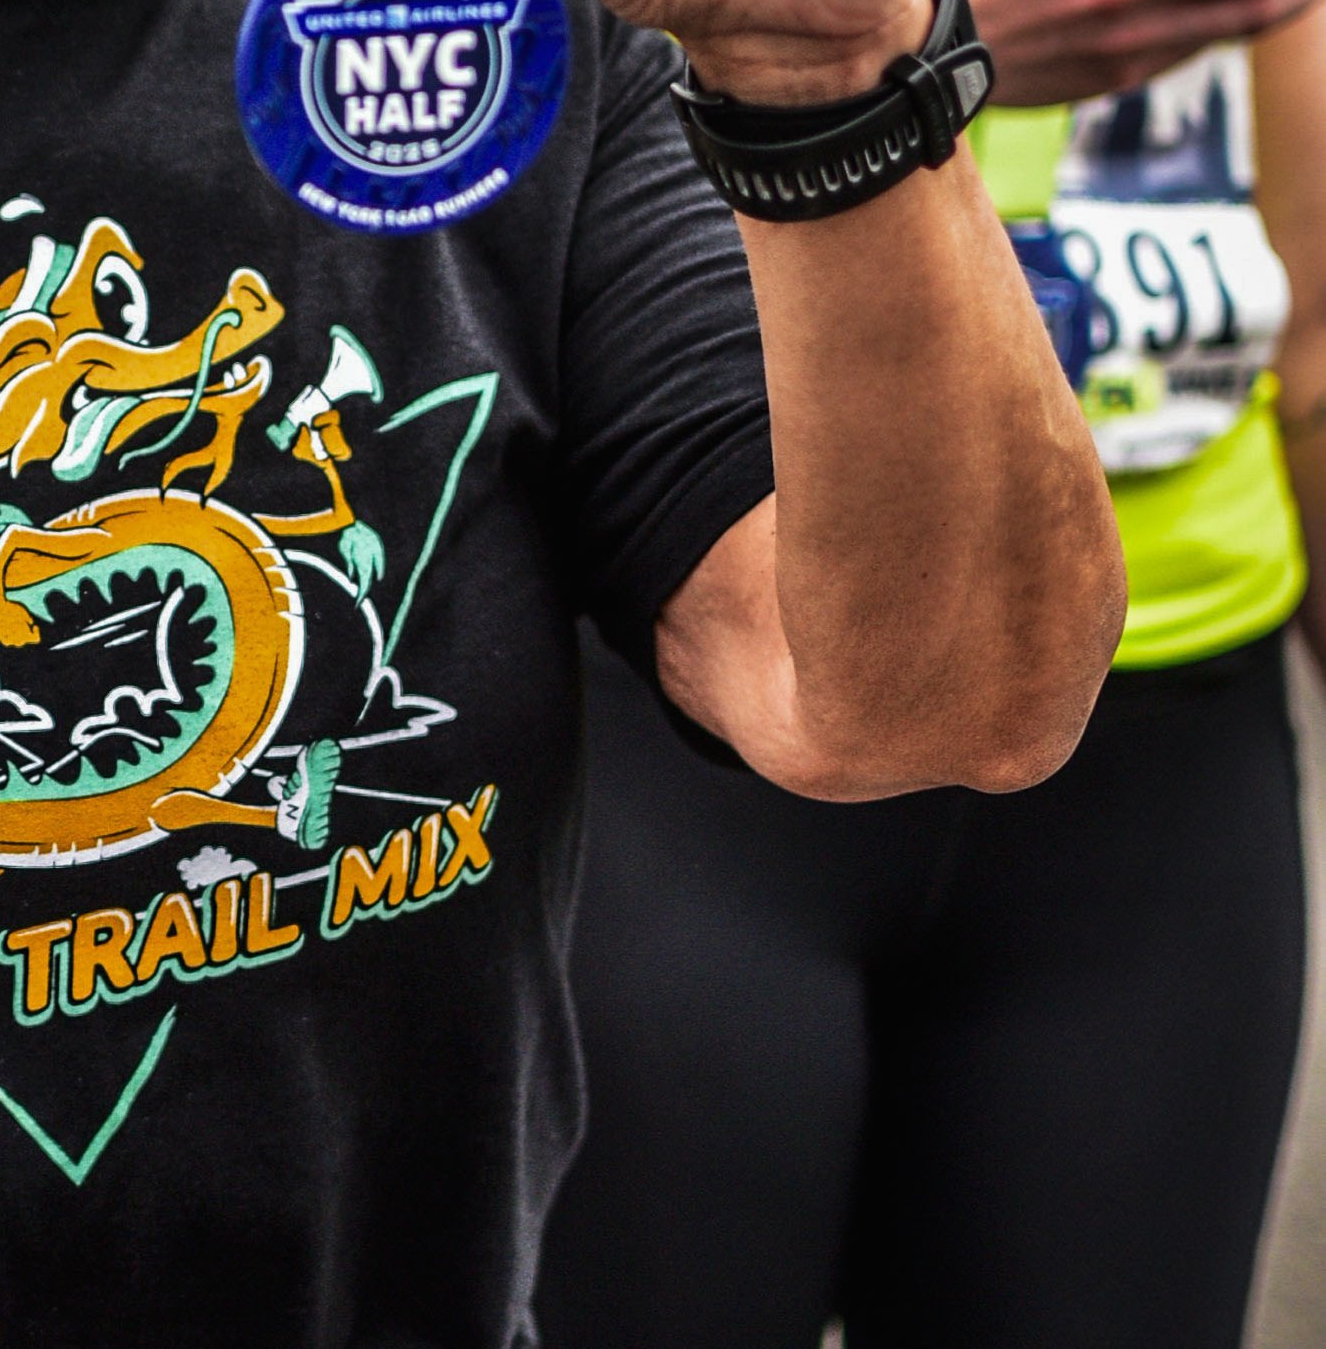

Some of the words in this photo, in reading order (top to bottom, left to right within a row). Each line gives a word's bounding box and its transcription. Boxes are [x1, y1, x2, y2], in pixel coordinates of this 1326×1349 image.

[305, 9, 384, 31] UNITED
[411, 1, 508, 24] AIRLINES
[335, 29, 477, 95] NYC
[344, 89, 467, 136] HALF
[298, 181, 338, 213] NEW
[338, 201, 383, 226] YORK
[385, 205, 434, 227] ROAD
[434, 167, 510, 219] RUNNERS
[324, 782, 496, 934] MIX
